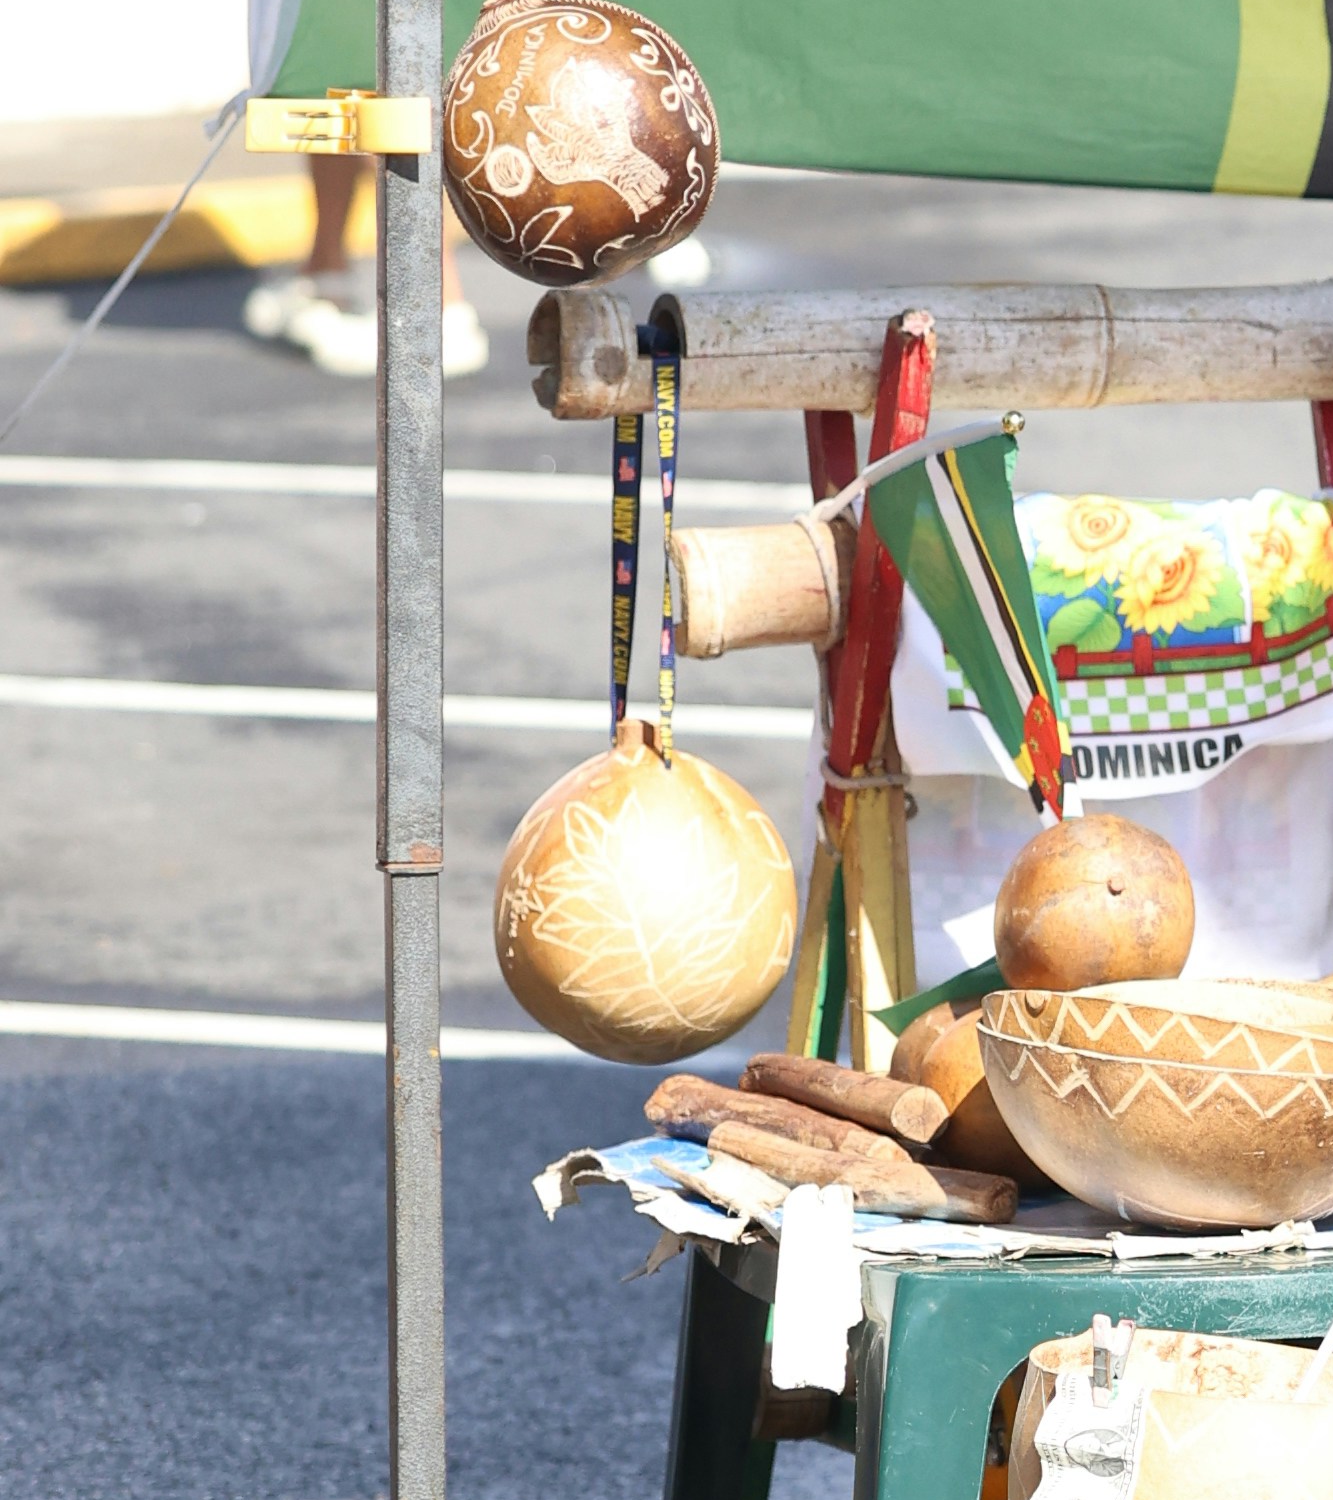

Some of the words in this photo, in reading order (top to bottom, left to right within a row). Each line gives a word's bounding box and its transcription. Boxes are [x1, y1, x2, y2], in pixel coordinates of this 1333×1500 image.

[495, 23, 549, 119] DOMINICA
[656, 365, 676, 458] NAVY.COM
[613, 496, 636, 546] NAVY
[1072, 732, 1244, 780] OMINICA
